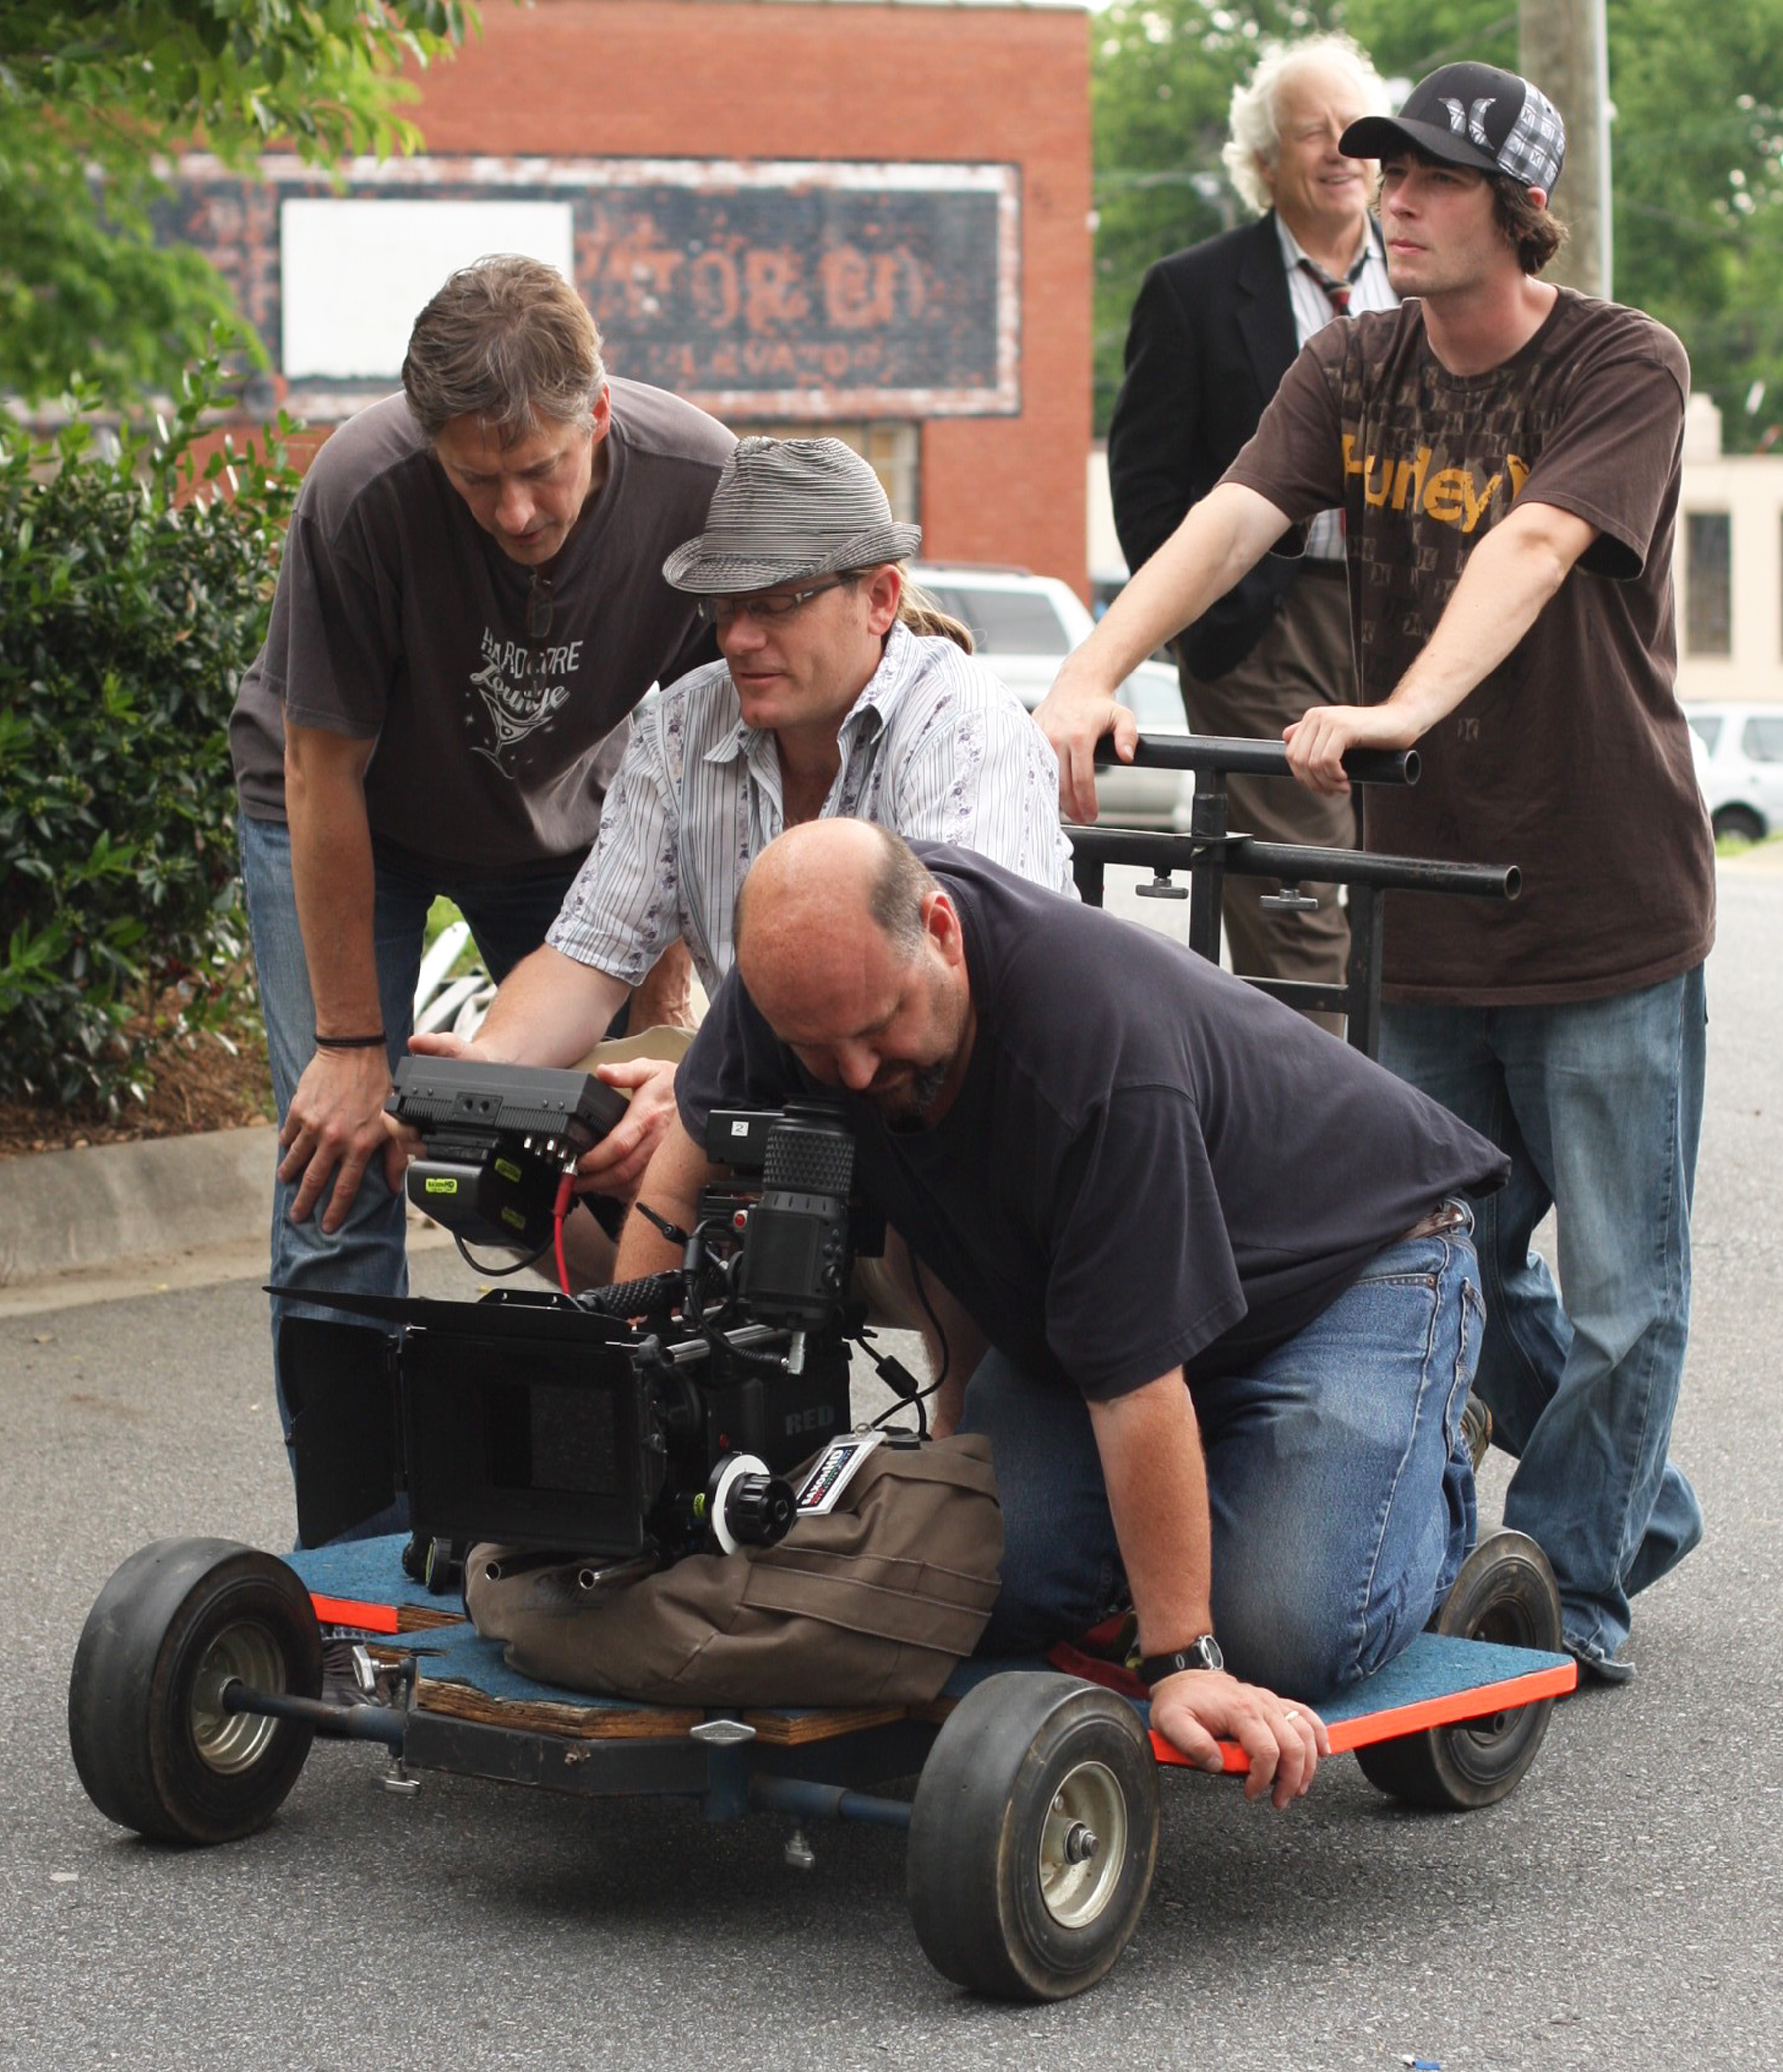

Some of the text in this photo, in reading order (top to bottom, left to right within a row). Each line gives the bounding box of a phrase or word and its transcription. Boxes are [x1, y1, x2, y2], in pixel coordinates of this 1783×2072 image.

[1342, 434, 1503, 533] Hurley
[480, 626, 583, 678] HARDCORE
[735, 1124, 744, 1132] 2
[784, 1405, 835, 1436] RED
